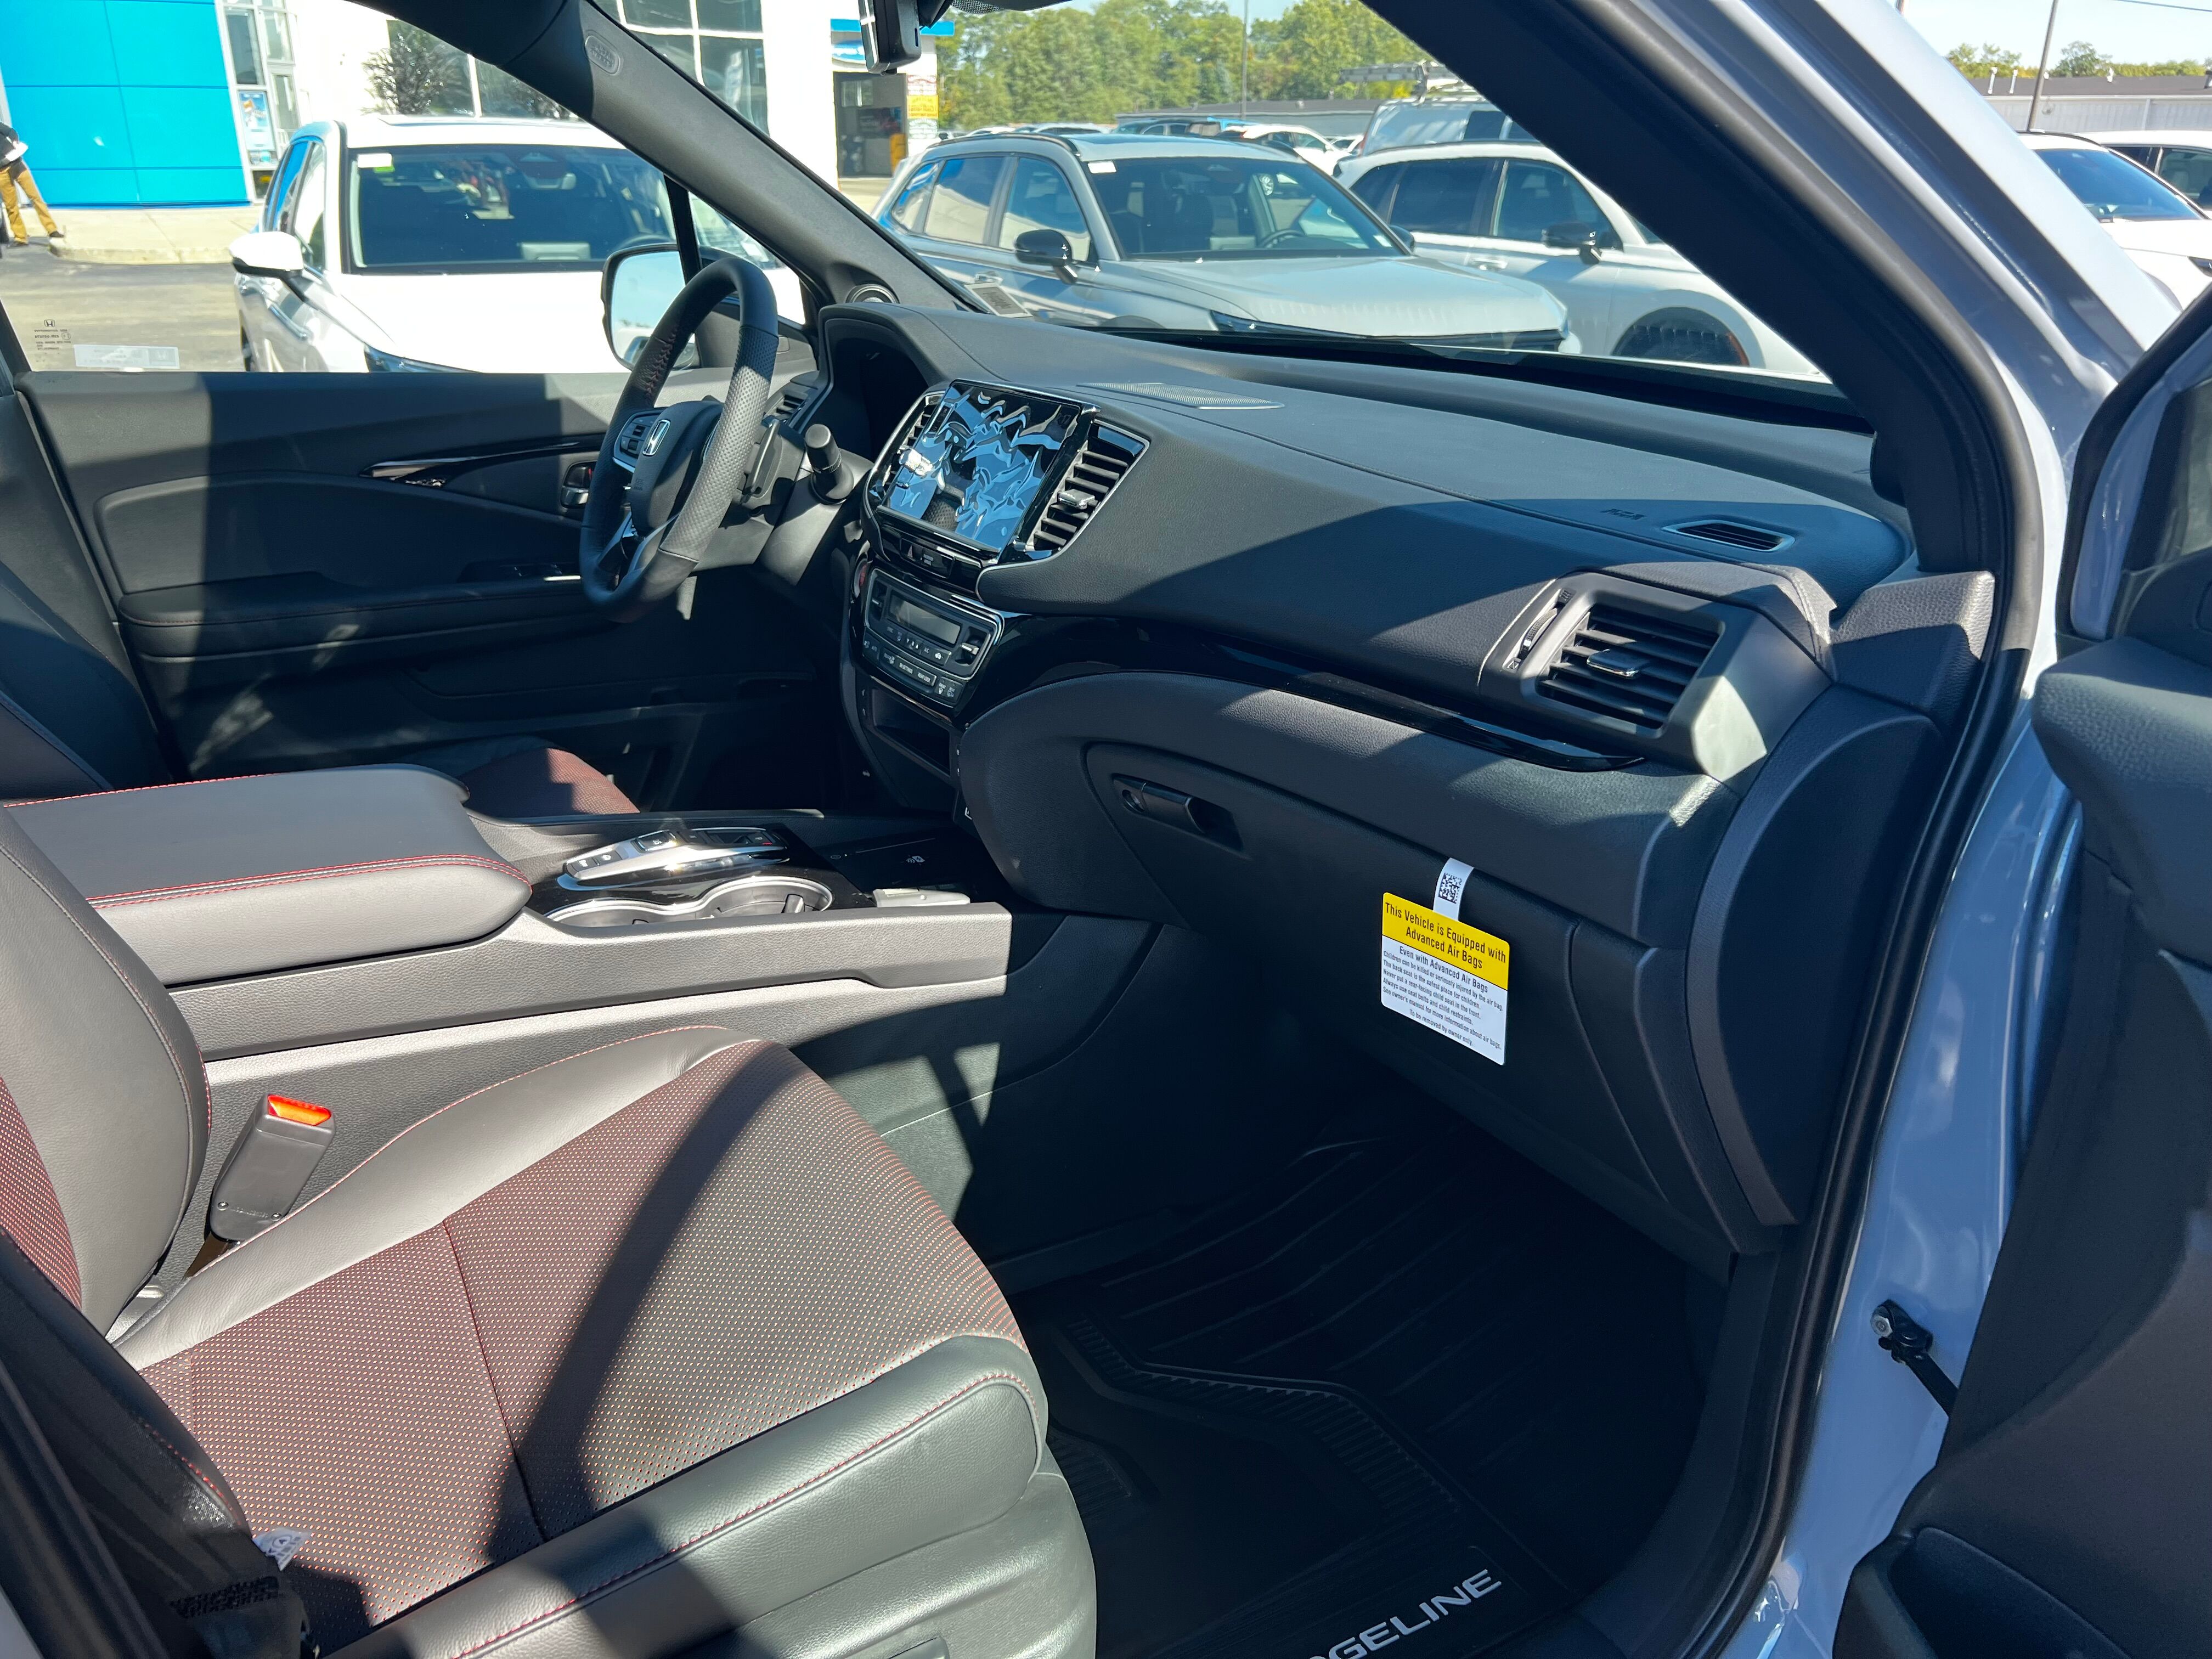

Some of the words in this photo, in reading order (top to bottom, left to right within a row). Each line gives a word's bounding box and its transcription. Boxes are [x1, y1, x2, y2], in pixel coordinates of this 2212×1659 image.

[1385, 902, 1402, 918] This
[1405, 910, 1434, 932] Vehicle
[1437, 923, 1444, 936] is
[1447, 927, 1485, 954] Equipped
[1488, 947, 1506, 963] with
[1406, 926, 1445, 952] Advanced
[1447, 944, 1460, 958] Air
[1462, 950, 1482, 969] Bags
[1383, 959, 1391, 968] The
[1383, 950, 1401, 963] Children
[1417, 965, 1429, 975] killed
[1472, 990, 1477, 999] by
[1400, 945, 1414, 959] Even
[1415, 954, 1429, 966] with
[1430, 959, 1460, 980] Advanced
[1462, 973, 1471, 984] Air
[1472, 978, 1488, 993] Bags
[1415, 1012, 1421, 1020] be
[1442, 1025, 1448, 1034] by
[1309, 1569, 1502, 1659] GELINE
